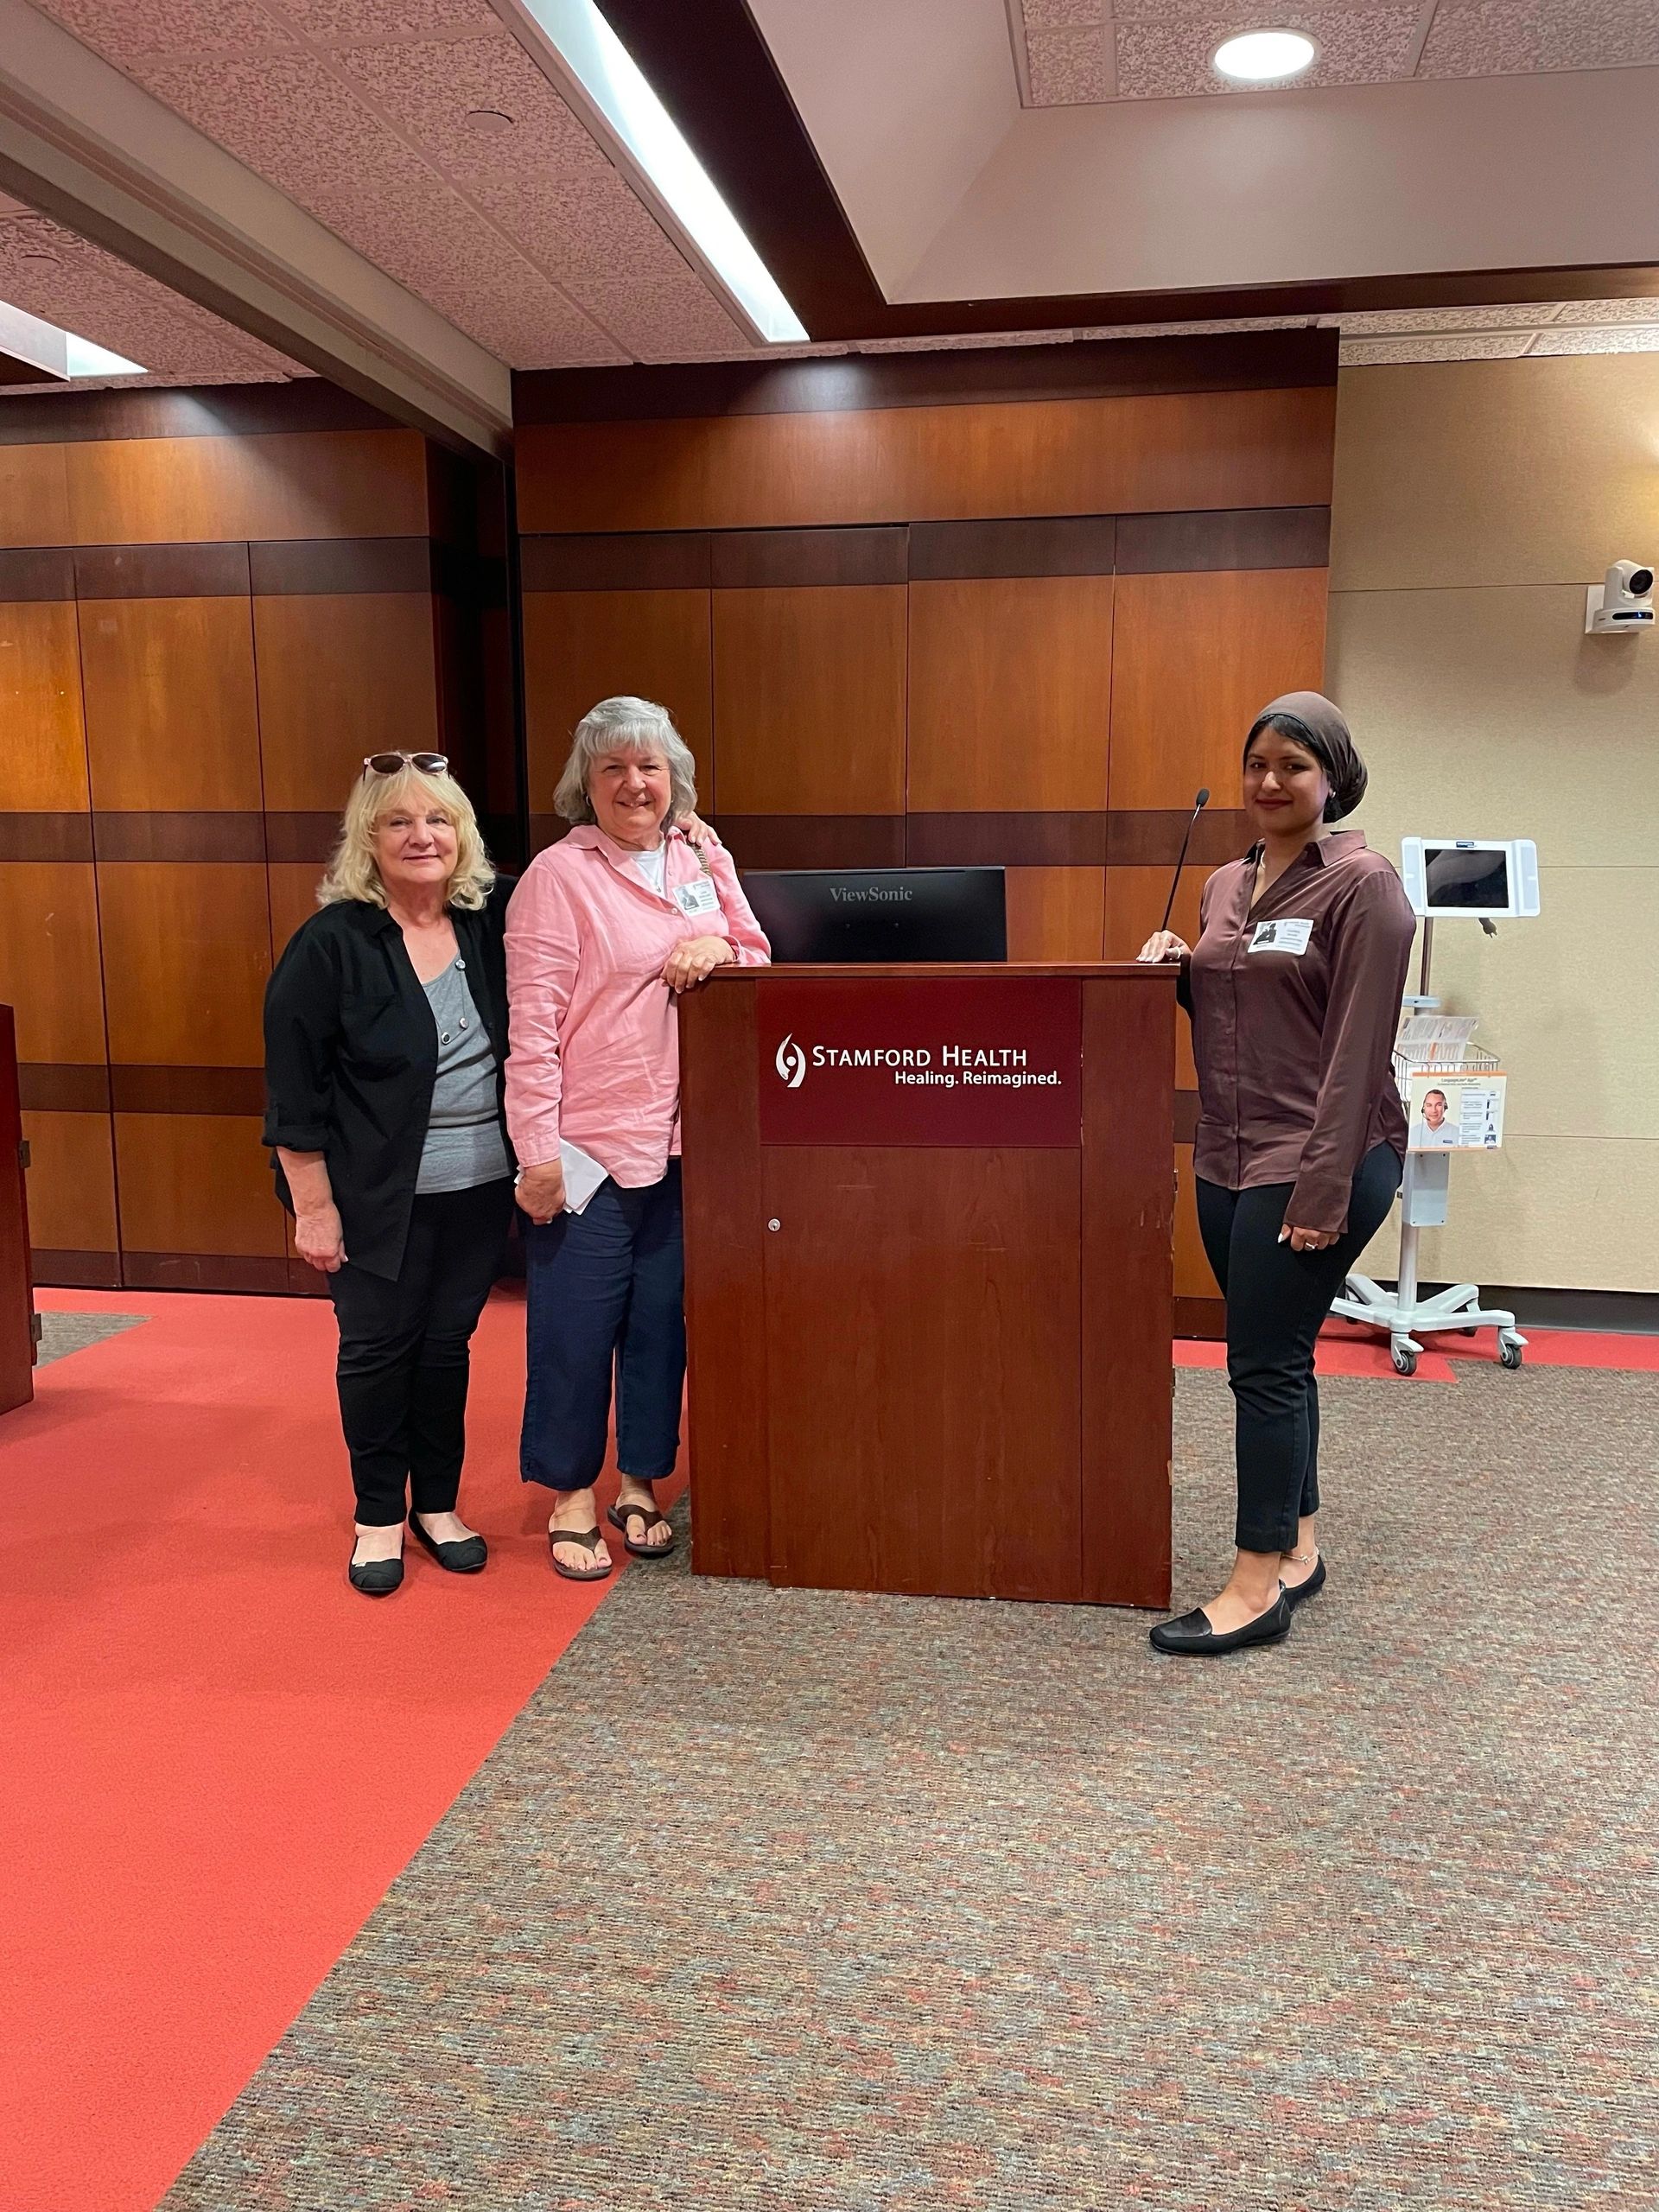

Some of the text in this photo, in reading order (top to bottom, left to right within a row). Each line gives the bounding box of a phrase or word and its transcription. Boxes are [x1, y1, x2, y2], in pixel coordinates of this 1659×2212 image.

[830, 887, 912, 902] ViewSonic
[813, 1046, 1027, 1067] STAMFORD HEALTH
[895, 1071, 1062, 1089] Healing. Reimagined.
